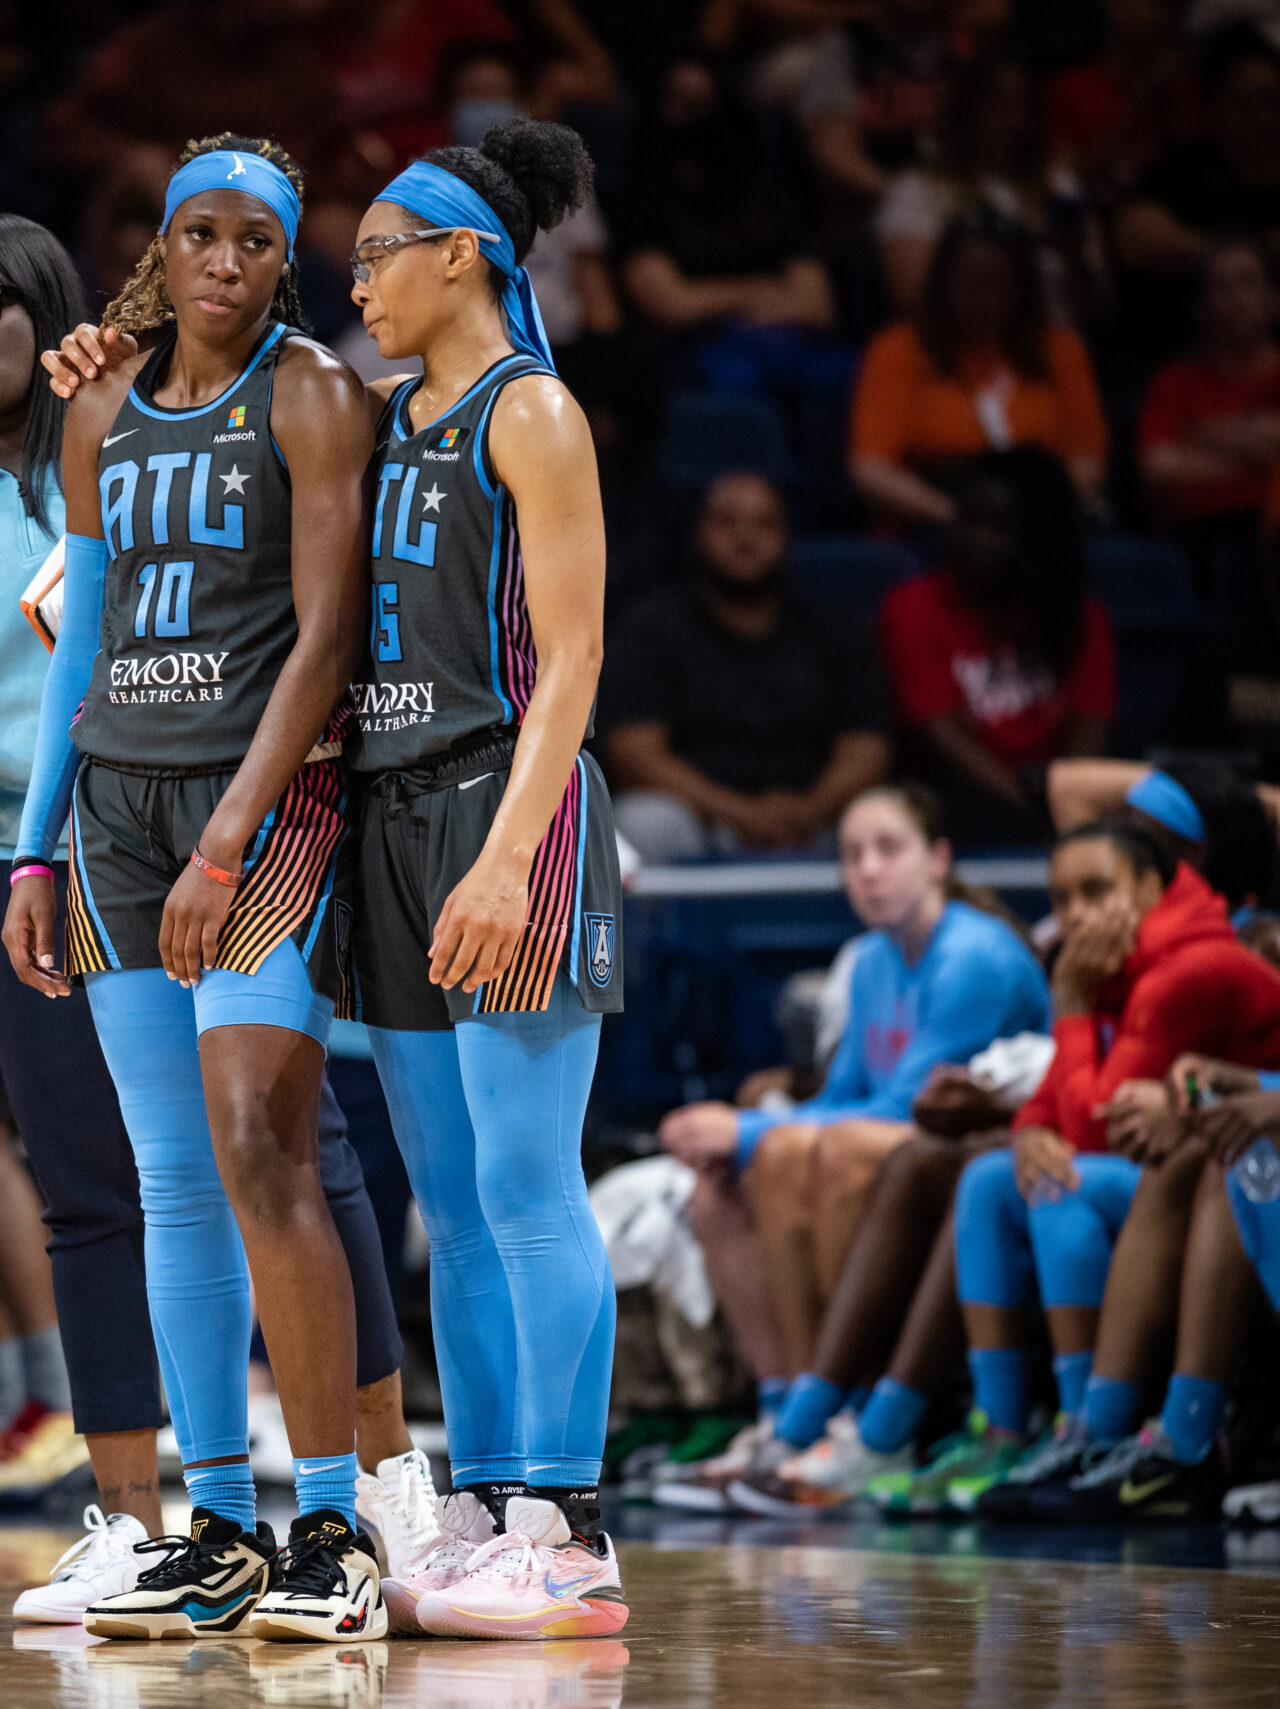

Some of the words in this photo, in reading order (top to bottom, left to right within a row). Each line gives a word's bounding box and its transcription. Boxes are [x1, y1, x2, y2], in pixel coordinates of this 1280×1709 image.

[213, 430, 256, 444] Microsoft
[422, 449, 460, 462] Microsoft
[98, 452, 244, 561] ATL
[372, 463, 438, 568] TL
[135, 561, 195, 638] 10
[371, 583, 402, 662] 5
[110, 651, 230, 686] EMORY
[108, 687, 224, 704] HEALTHCARE
[501, 1486, 525, 1495] ARYSE
